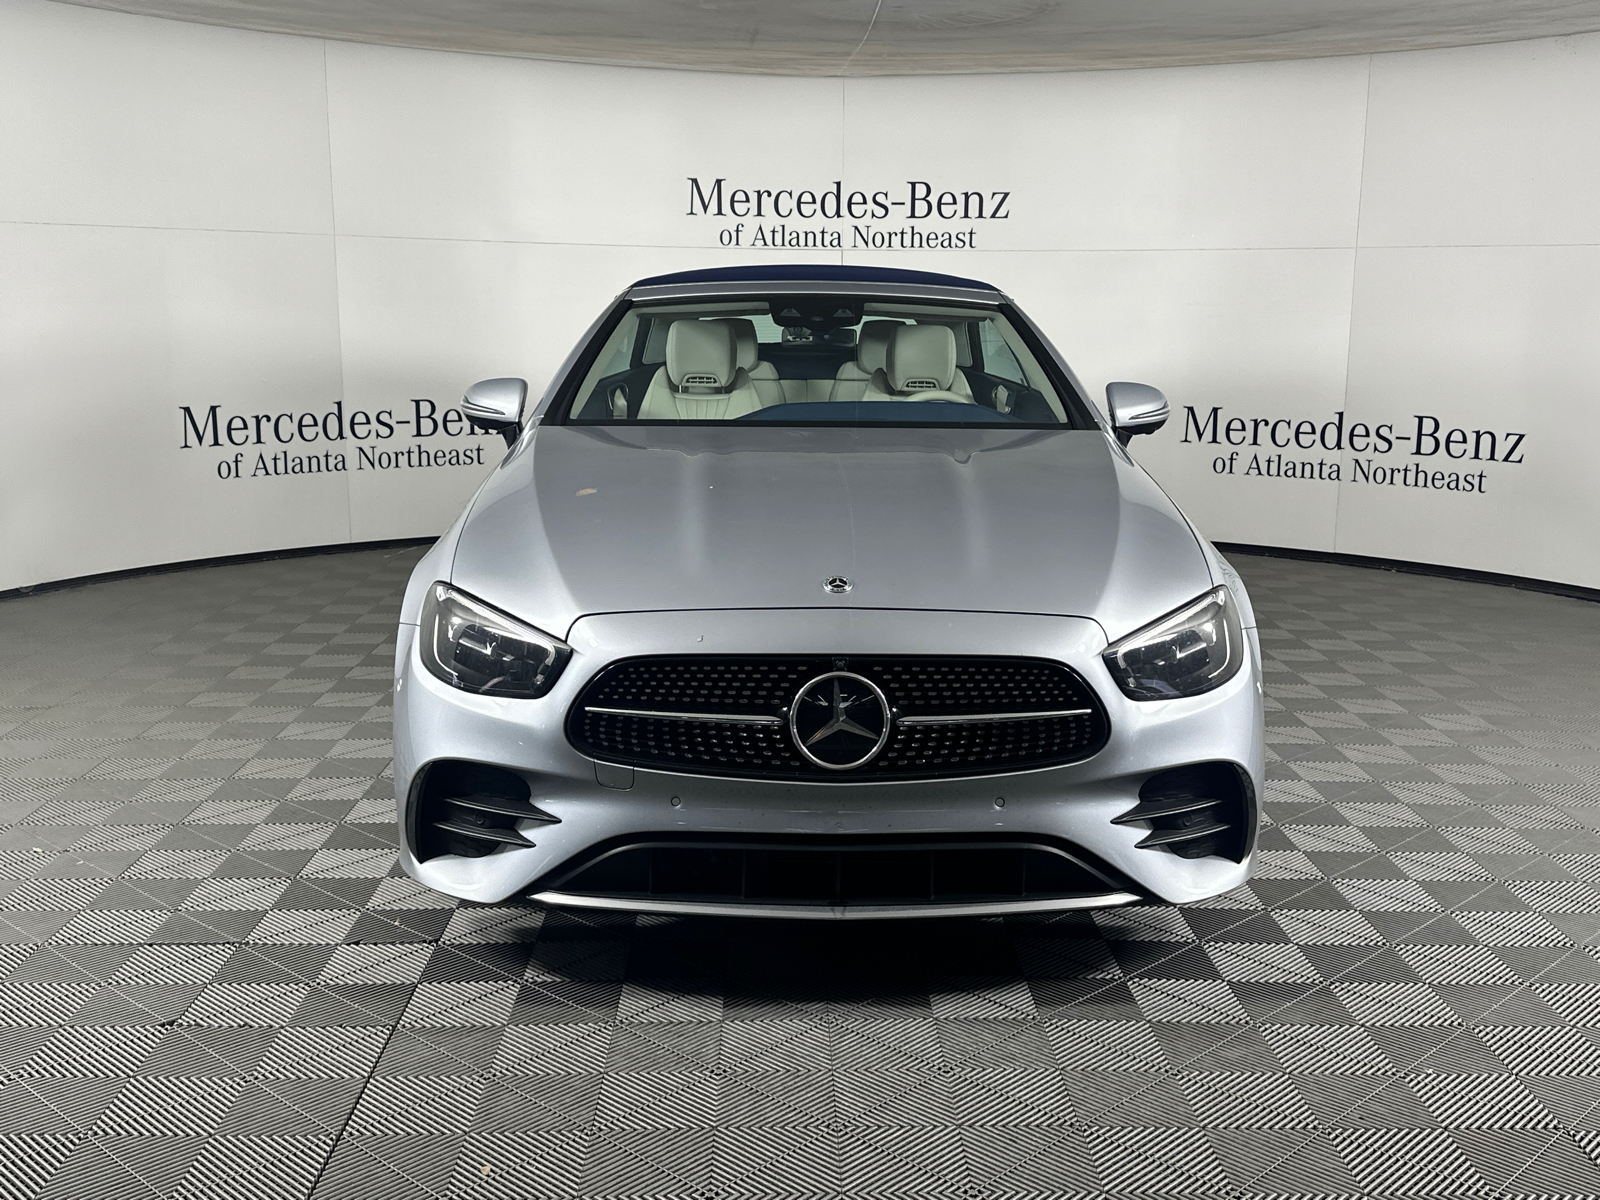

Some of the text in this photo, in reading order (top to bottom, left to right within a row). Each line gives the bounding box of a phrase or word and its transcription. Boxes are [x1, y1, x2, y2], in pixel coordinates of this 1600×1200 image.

[686, 177, 1011, 219] Mercedes-Benz
[719, 223, 977, 249] of Atlanta Northeast
[178, 398, 504, 450] Mercedes-Be
[1180, 405, 1526, 464] Mercedes-Benz
[217, 443, 485, 480] of Atlanta Northeast
[1212, 451, 1488, 494] of Atlanta Northeast
